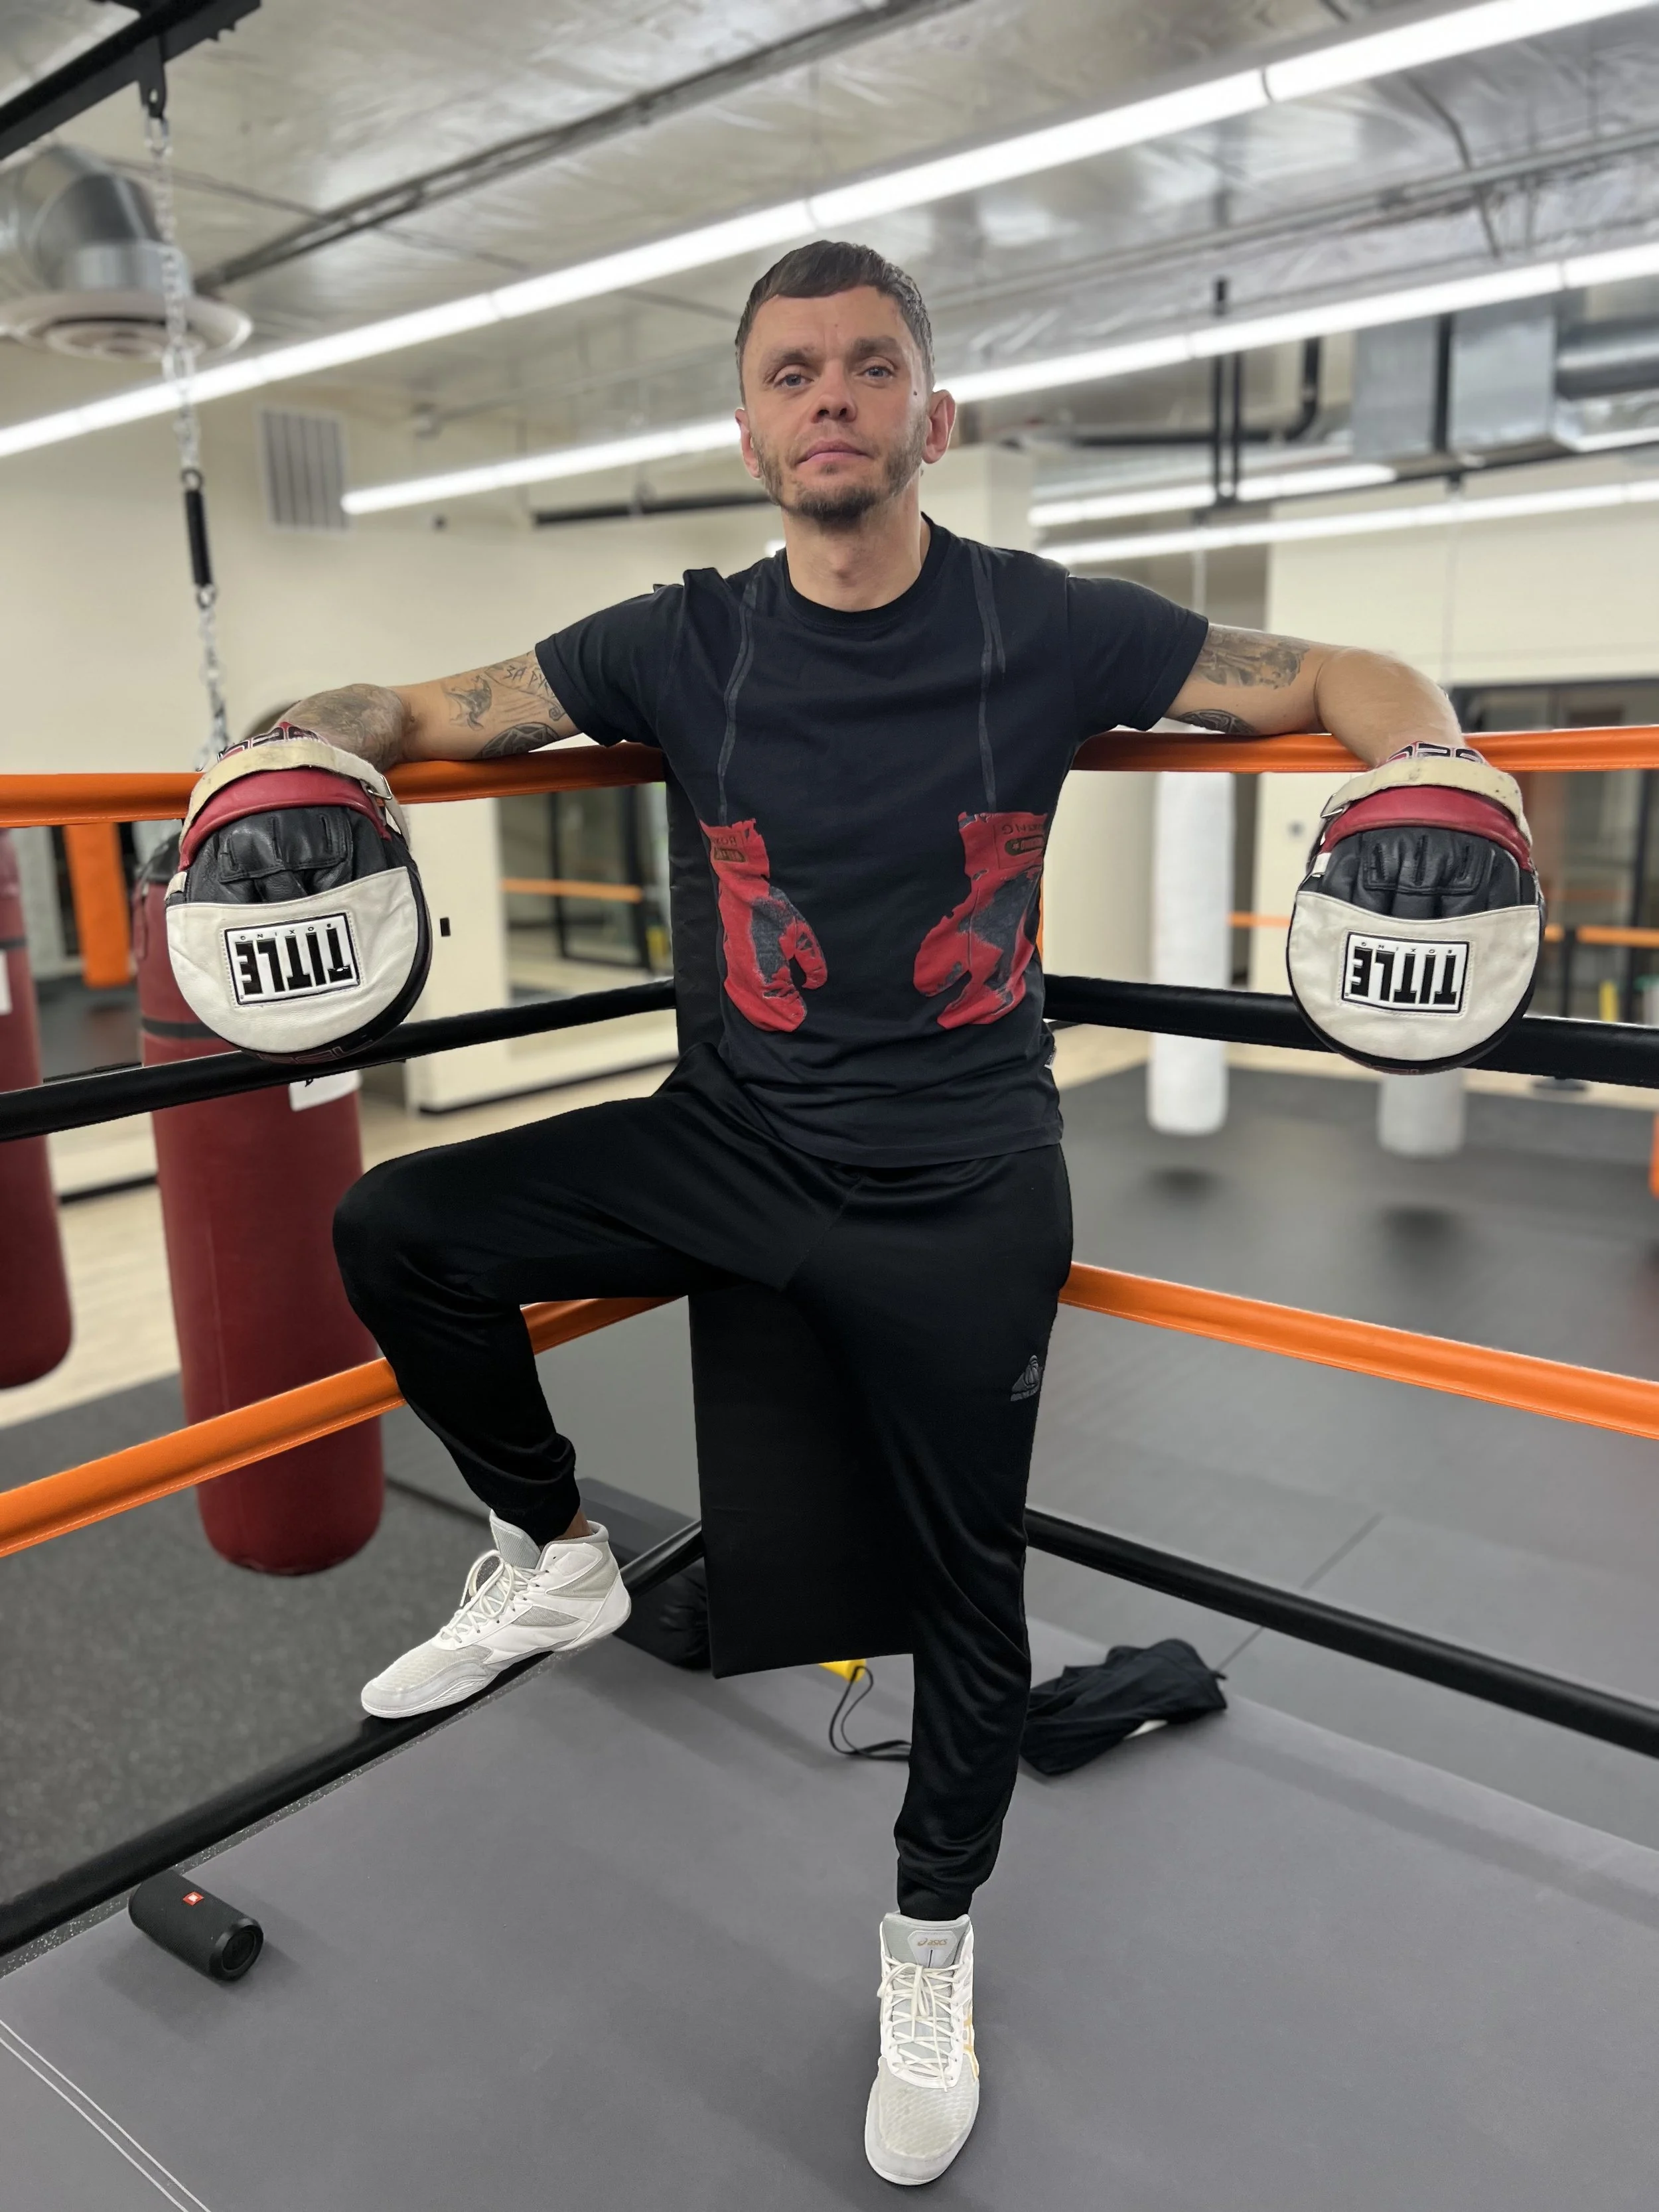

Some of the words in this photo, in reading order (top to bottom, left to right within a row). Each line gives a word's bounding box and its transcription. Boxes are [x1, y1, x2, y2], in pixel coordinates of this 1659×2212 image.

[240, 922, 332, 941] BOXING
[1361, 941, 1453, 954] BOXING
[235, 928, 353, 995] TITLE
[1350, 946, 1458, 1005] TITLE
